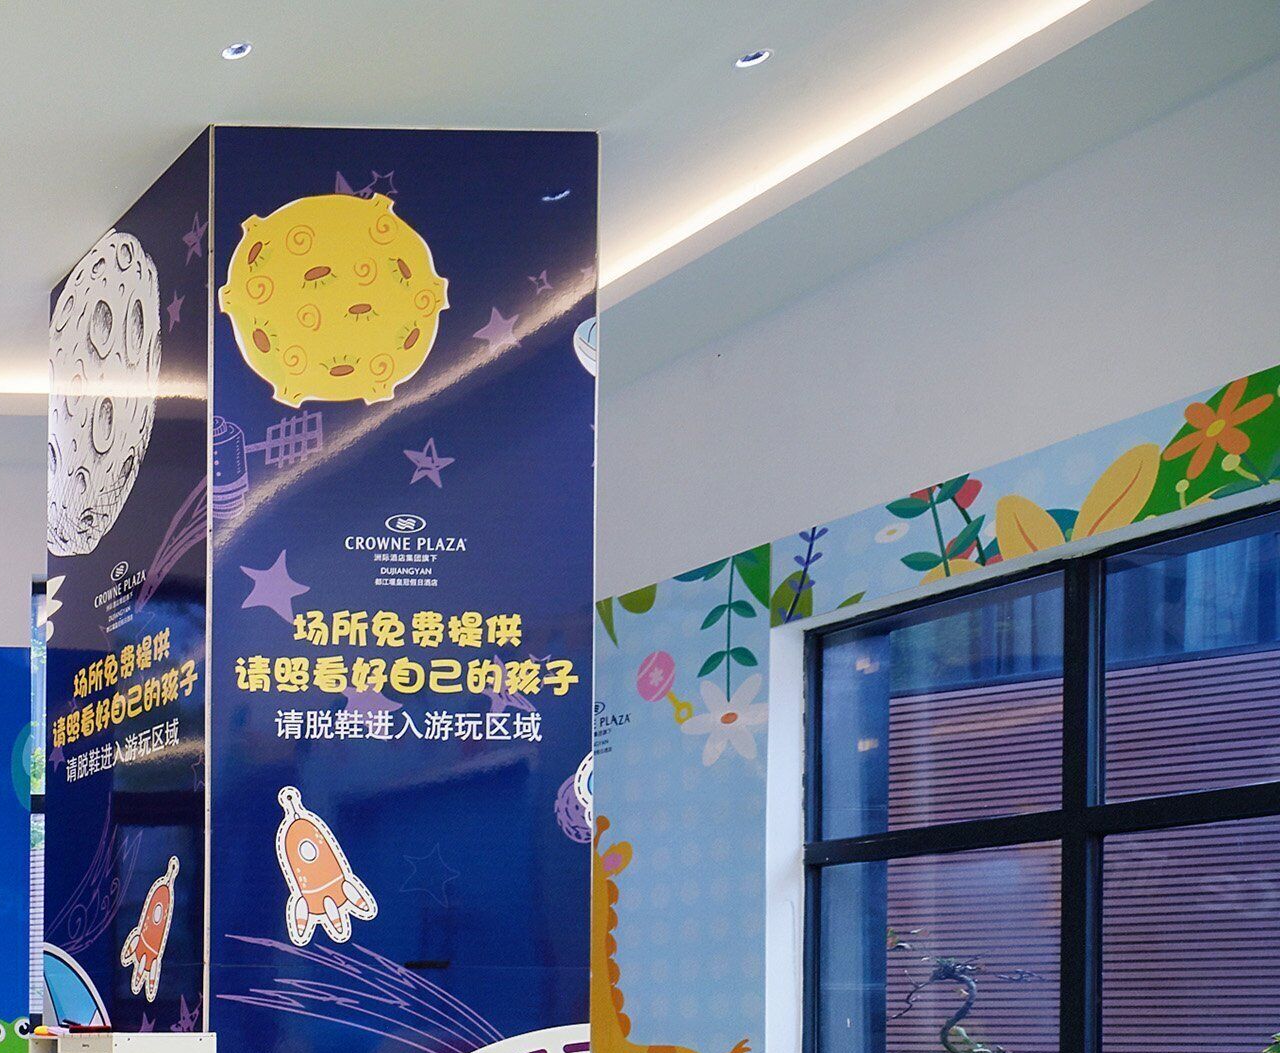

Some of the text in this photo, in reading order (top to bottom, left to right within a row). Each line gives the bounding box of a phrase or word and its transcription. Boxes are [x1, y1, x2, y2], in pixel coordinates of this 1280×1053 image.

[344, 536, 467, 552] CROWNE PLAZA
[374, 554, 438, 562] 洲际酒店集团旗下
[94, 583, 122, 608] CROWNE
[123, 569, 146, 592] PLAZA
[380, 567, 432, 576] DUJIANGYAN
[292, 610, 523, 648] 场所免费提供
[73, 627, 170, 698] 场所免费提供
[234, 655, 580, 696] 请照看好自己的孩子
[52, 659, 198, 748] 请照看好自己的孩子
[600, 714, 631, 727] PLAZA
[274, 709, 543, 742] 请脱鞋进入游玩区域
[65, 717, 180, 783] 请脱鞋进入游玩区域
